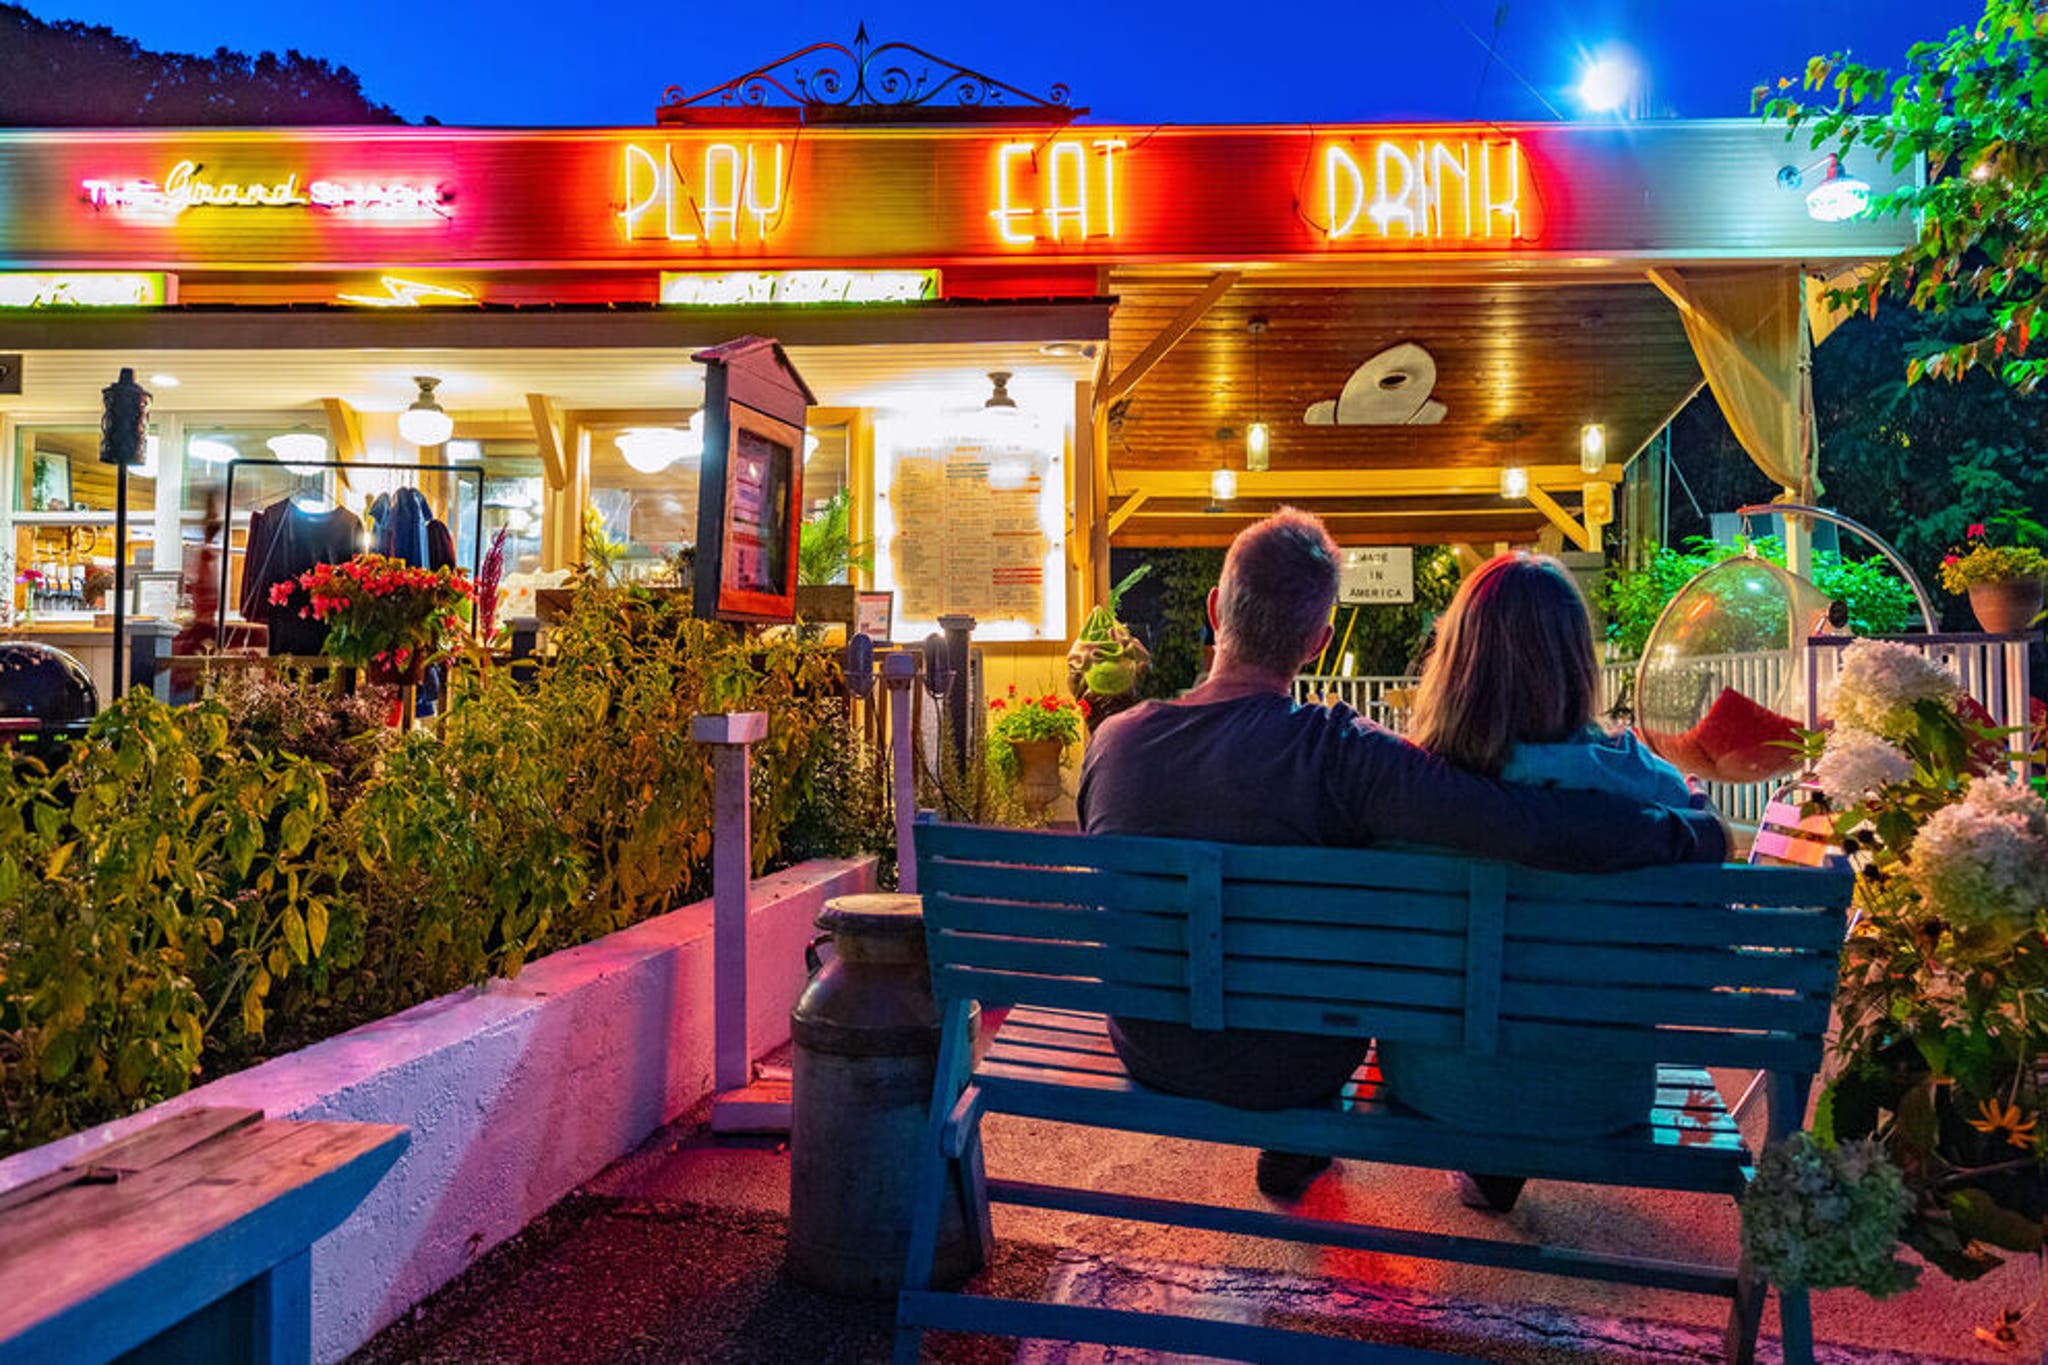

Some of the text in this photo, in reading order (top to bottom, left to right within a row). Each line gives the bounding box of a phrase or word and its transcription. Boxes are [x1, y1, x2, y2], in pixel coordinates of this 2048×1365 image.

[164, 159, 308, 207] Grand
[617, 138, 1521, 244] PLAY EAT DRINK
[1368, 570, 1384, 581] IN
[1348, 587, 1404, 599] AMERICA
